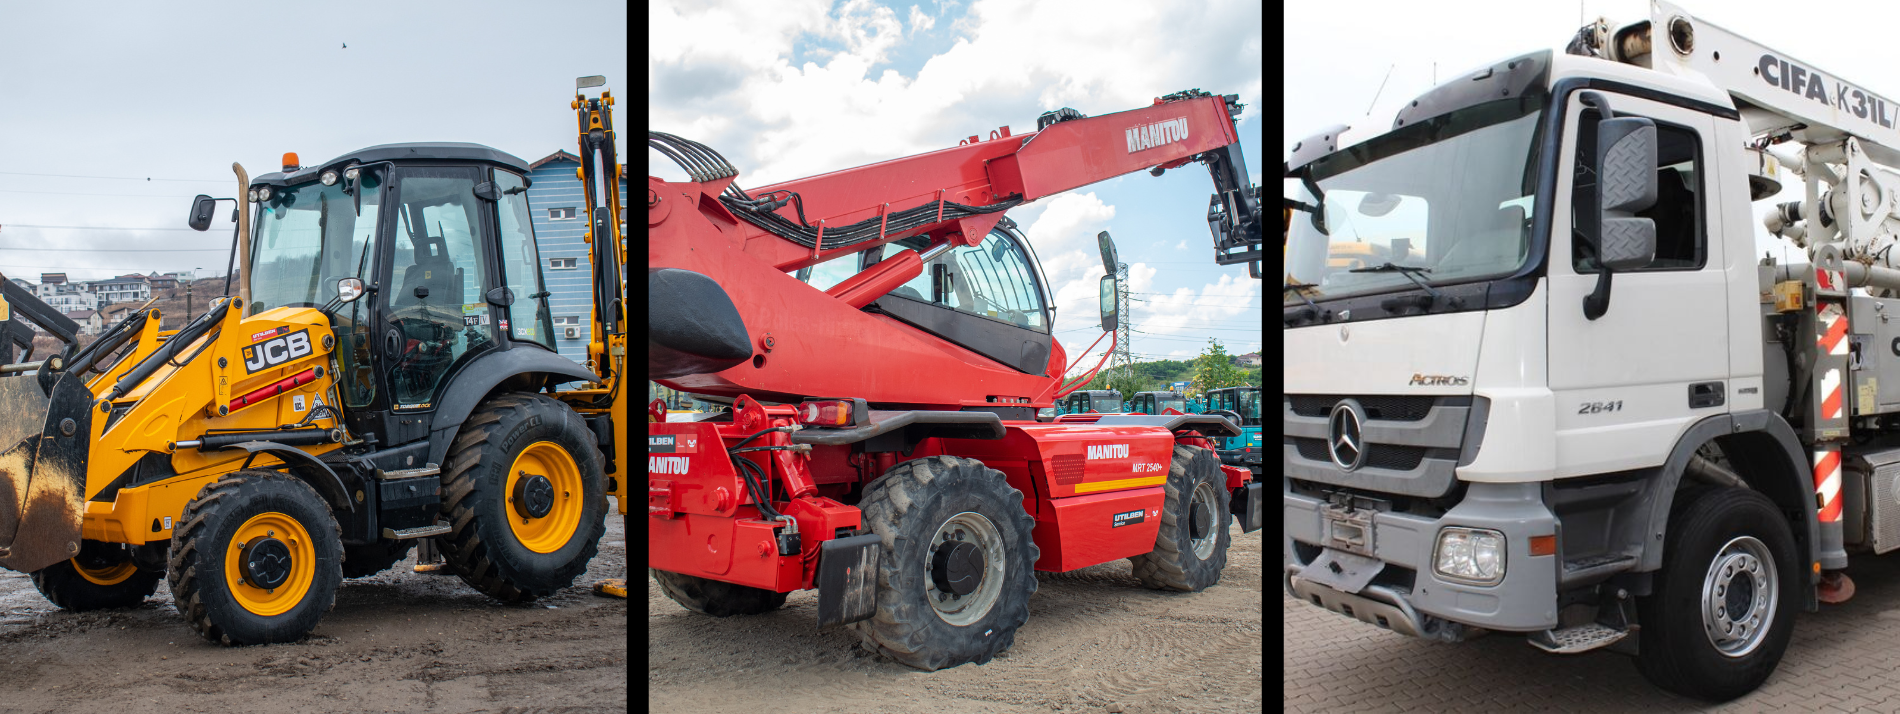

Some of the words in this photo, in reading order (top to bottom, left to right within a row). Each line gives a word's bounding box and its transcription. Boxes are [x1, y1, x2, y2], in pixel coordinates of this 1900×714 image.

[1758, 54, 1829, 106] CIFA
[1125, 117, 1189, 154] MANITOU
[252, 328, 276, 339] UTILBEN
[246, 331, 311, 371] JCB
[1577, 400, 1623, 414] 2641
[501, 423, 529, 452] Power
[1087, 443, 1129, 460] MANITOU
[649, 456, 690, 475] ANITOU
[1132, 463, 1146, 473] MRT
[1146, 462, 1163, 472] 2540+
[1114, 510, 1144, 521] UTILBEN
